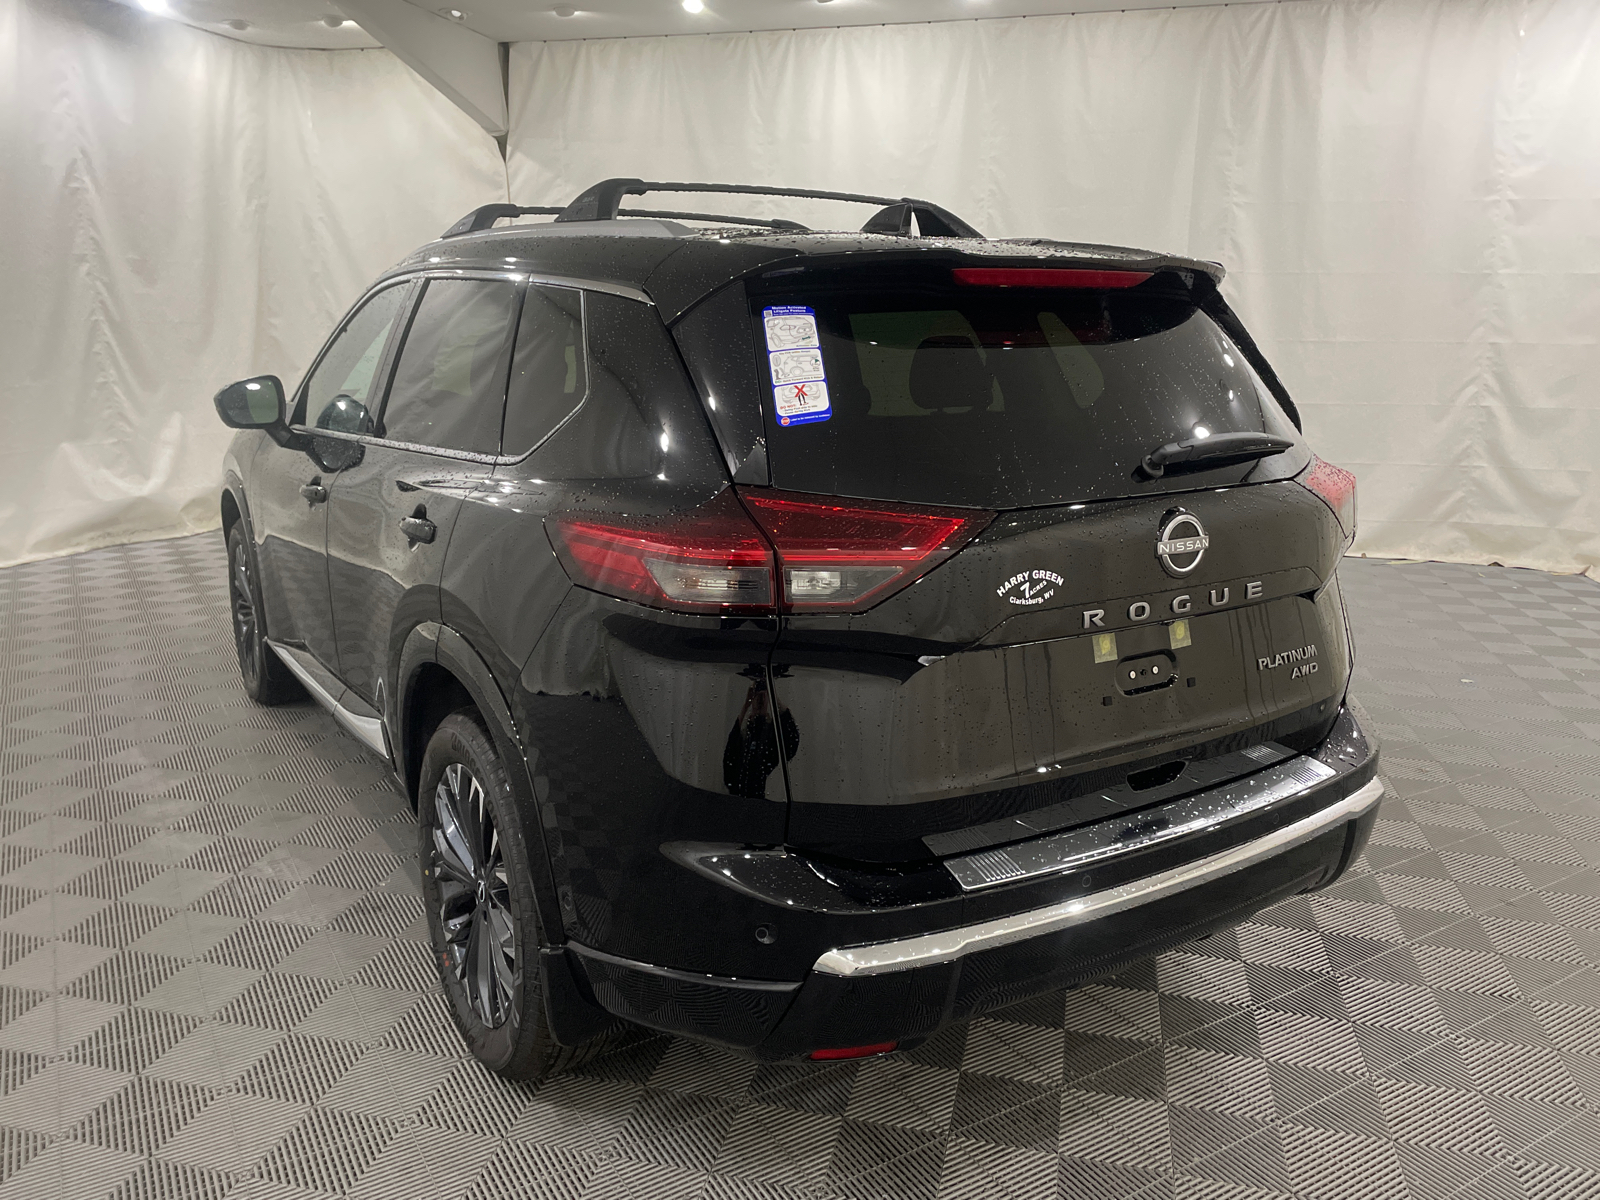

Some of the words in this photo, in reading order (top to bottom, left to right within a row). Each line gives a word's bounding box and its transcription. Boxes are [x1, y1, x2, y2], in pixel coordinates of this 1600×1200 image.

[1159, 538, 1209, 553] NISSAN
[996, 570, 1030, 597] HARRY
[1032, 569, 1065, 587] GREEN
[1019, 581, 1030, 599] 7
[1029, 580, 1048, 596] ACRES
[1009, 595, 1044, 605] Clarksburg,
[1043, 588, 1055, 600] WV
[1082, 581, 1263, 629] ROGUE
[1256, 644, 1319, 671] PLATINUM
[1291, 662, 1319, 680] AWD
